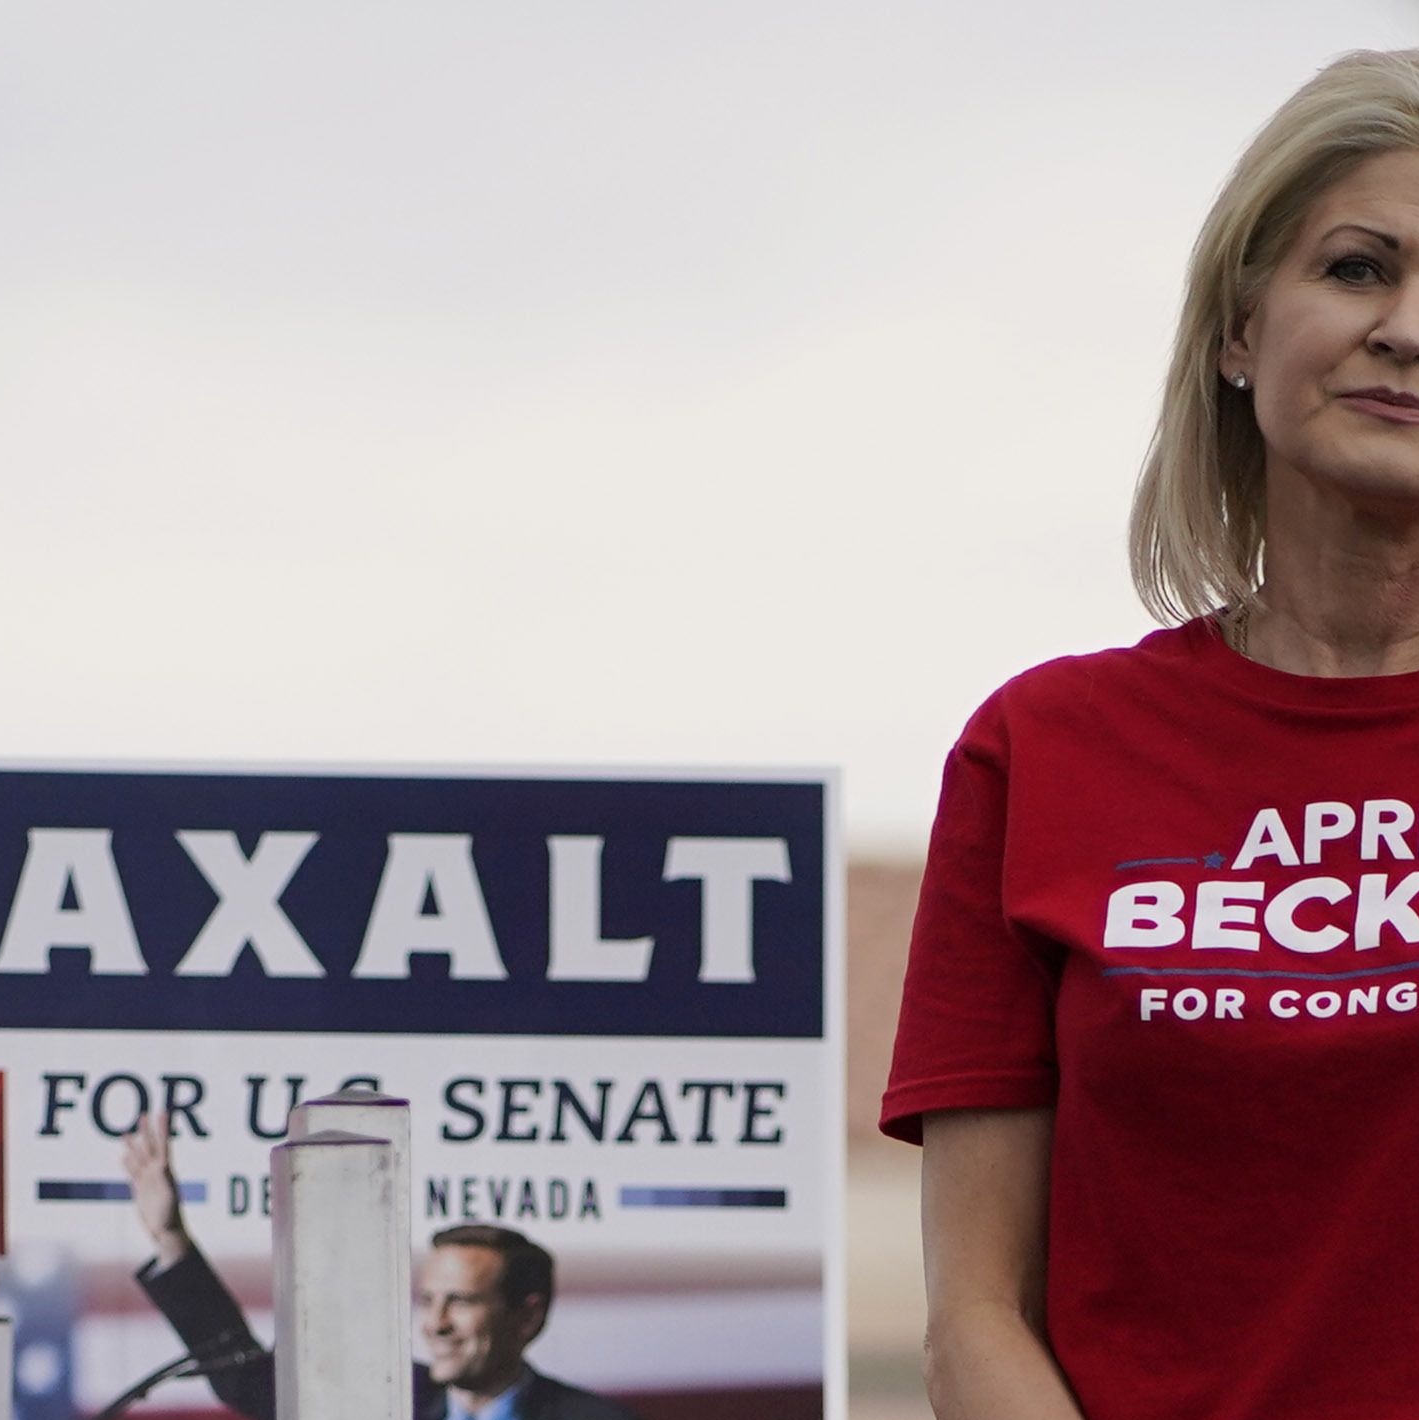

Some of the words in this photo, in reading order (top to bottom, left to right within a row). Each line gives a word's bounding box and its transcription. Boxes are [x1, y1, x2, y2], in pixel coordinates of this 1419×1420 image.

[1140, 988, 1246, 1021] FOR
[38, 1072, 209, 1139] FOR
[441, 1078, 788, 1144] SENATE
[427, 1177, 602, 1220] NEVADA
